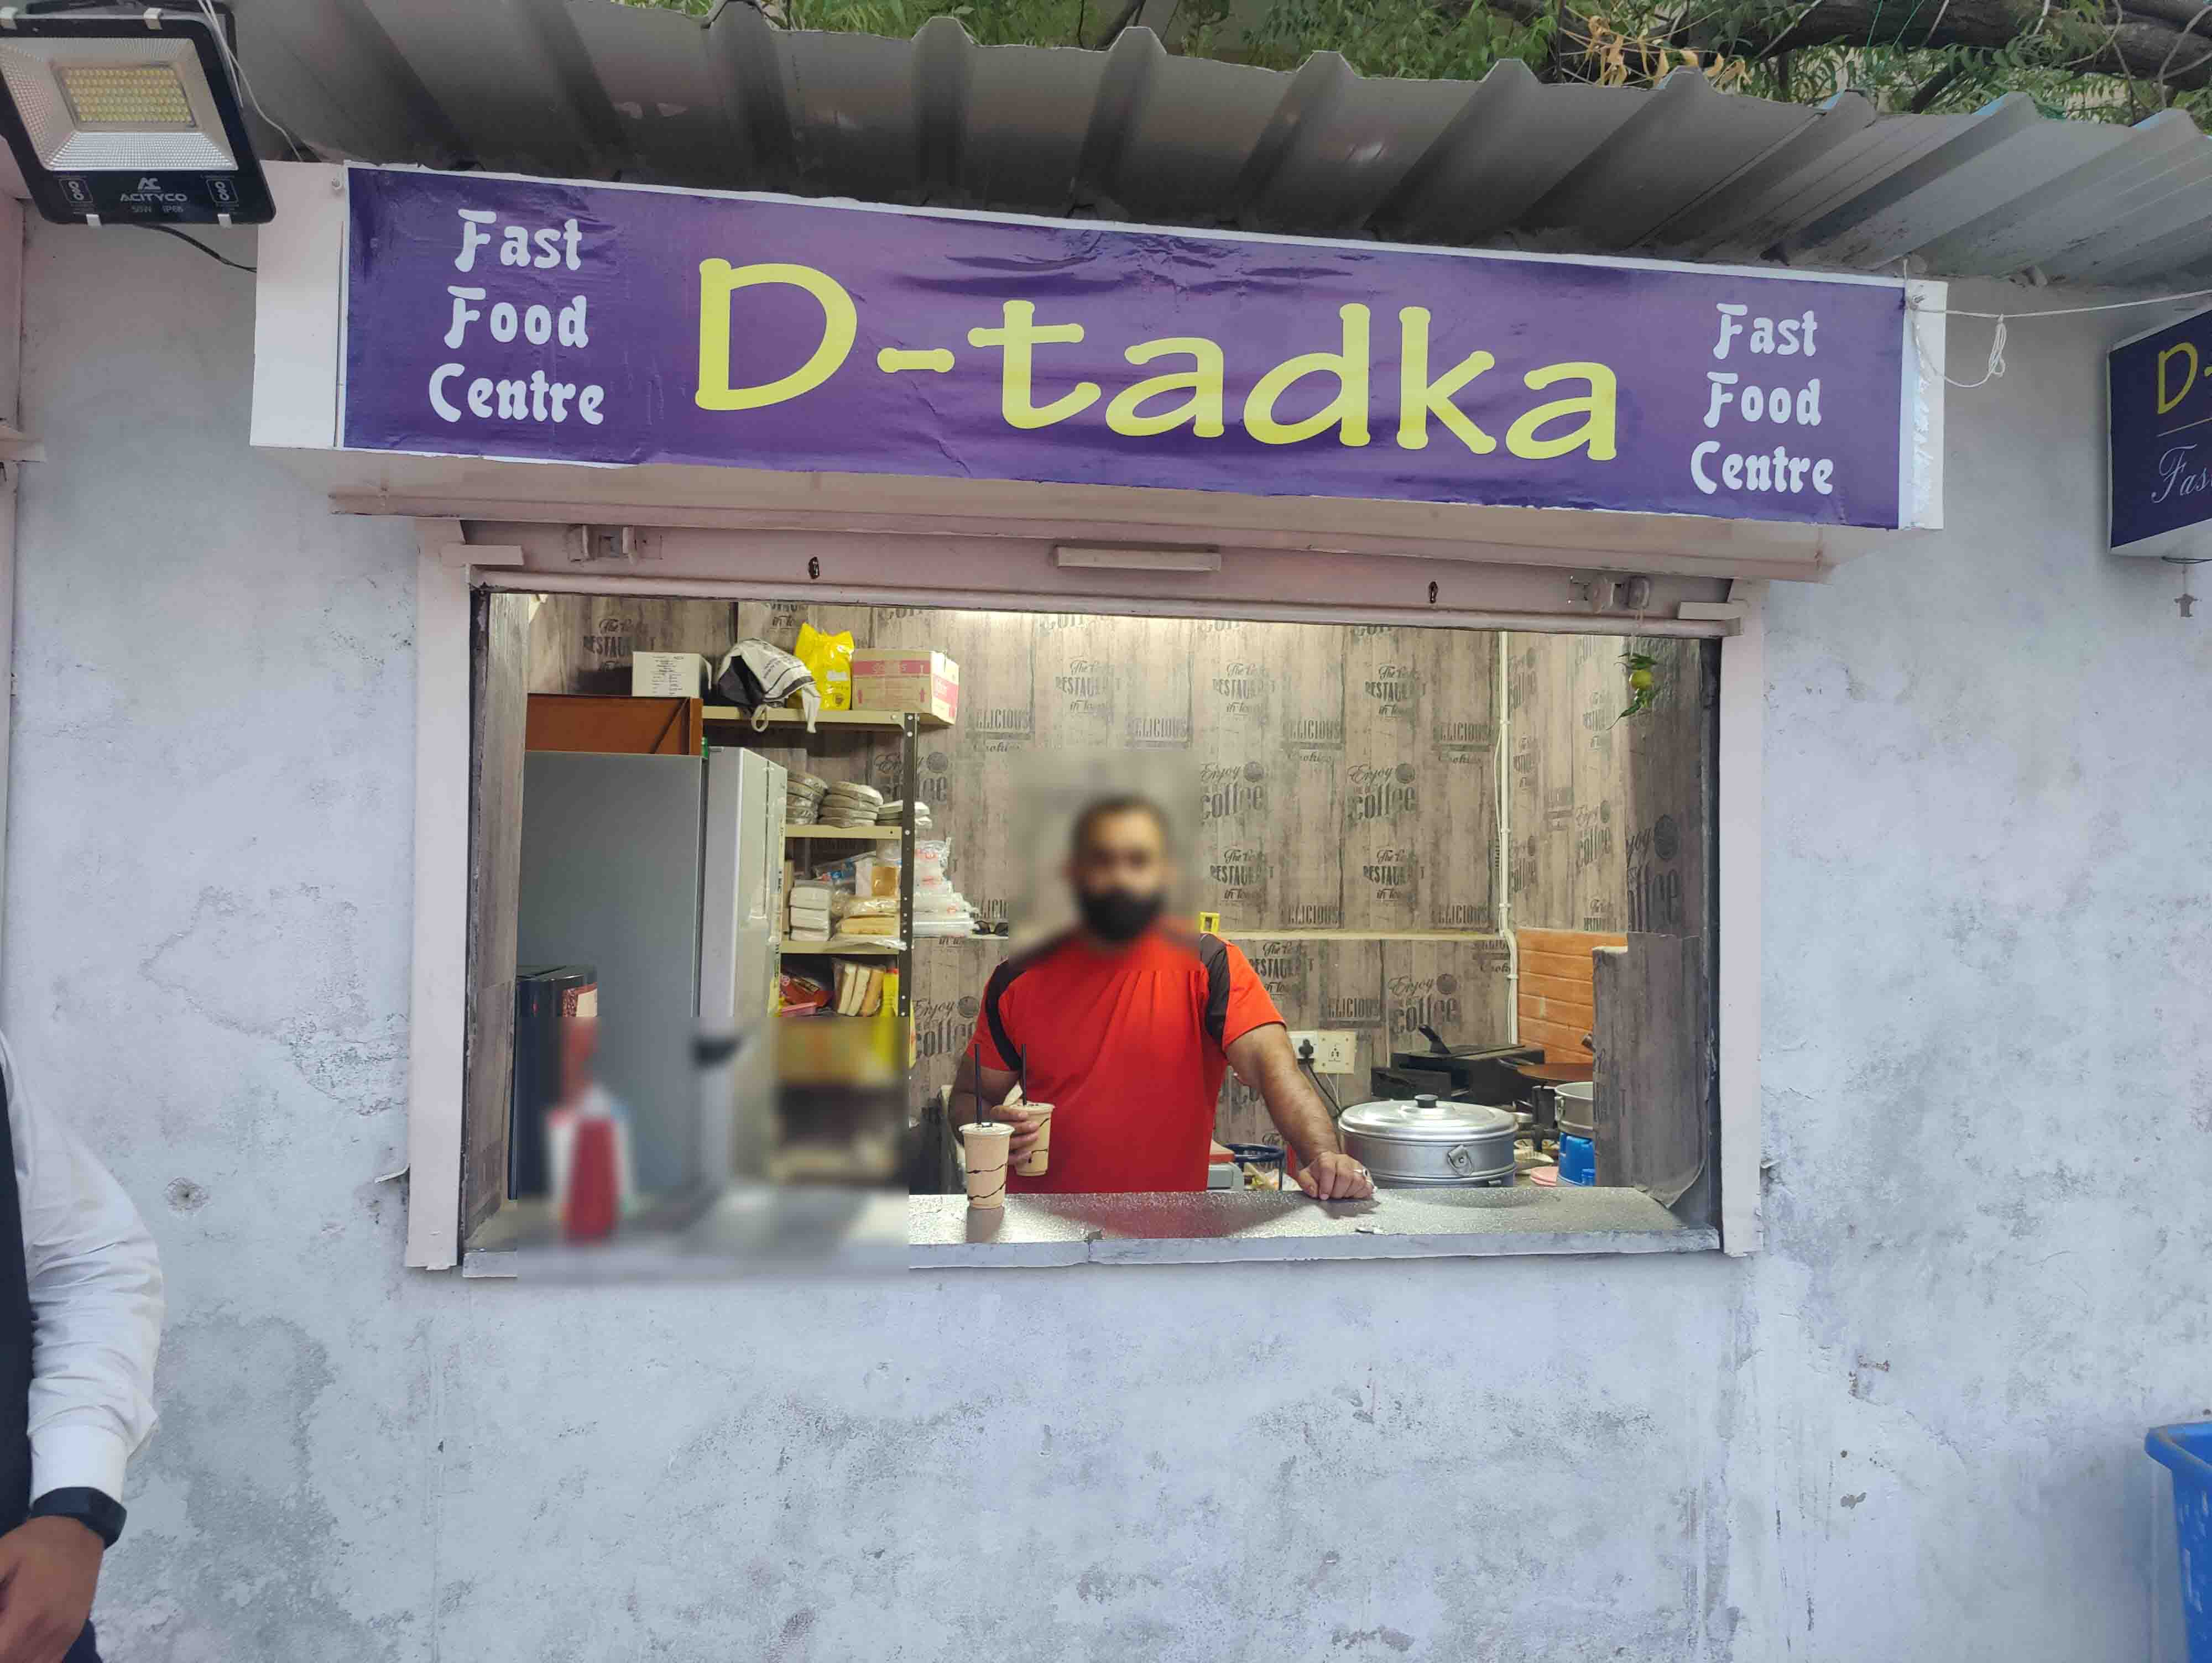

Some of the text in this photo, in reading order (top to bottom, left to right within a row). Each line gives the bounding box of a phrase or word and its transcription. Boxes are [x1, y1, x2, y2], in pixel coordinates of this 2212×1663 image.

[455, 208, 583, 273] Fast
[444, 285, 589, 349] Food
[1713, 303, 1818, 360] Fast
[694, 258, 1617, 461] D-tadka
[429, 363, 604, 425] Centre
[1703, 371, 1822, 428] Food
[1691, 441, 1834, 495] Centre
[2151, 444, 2212, 503] Fas
